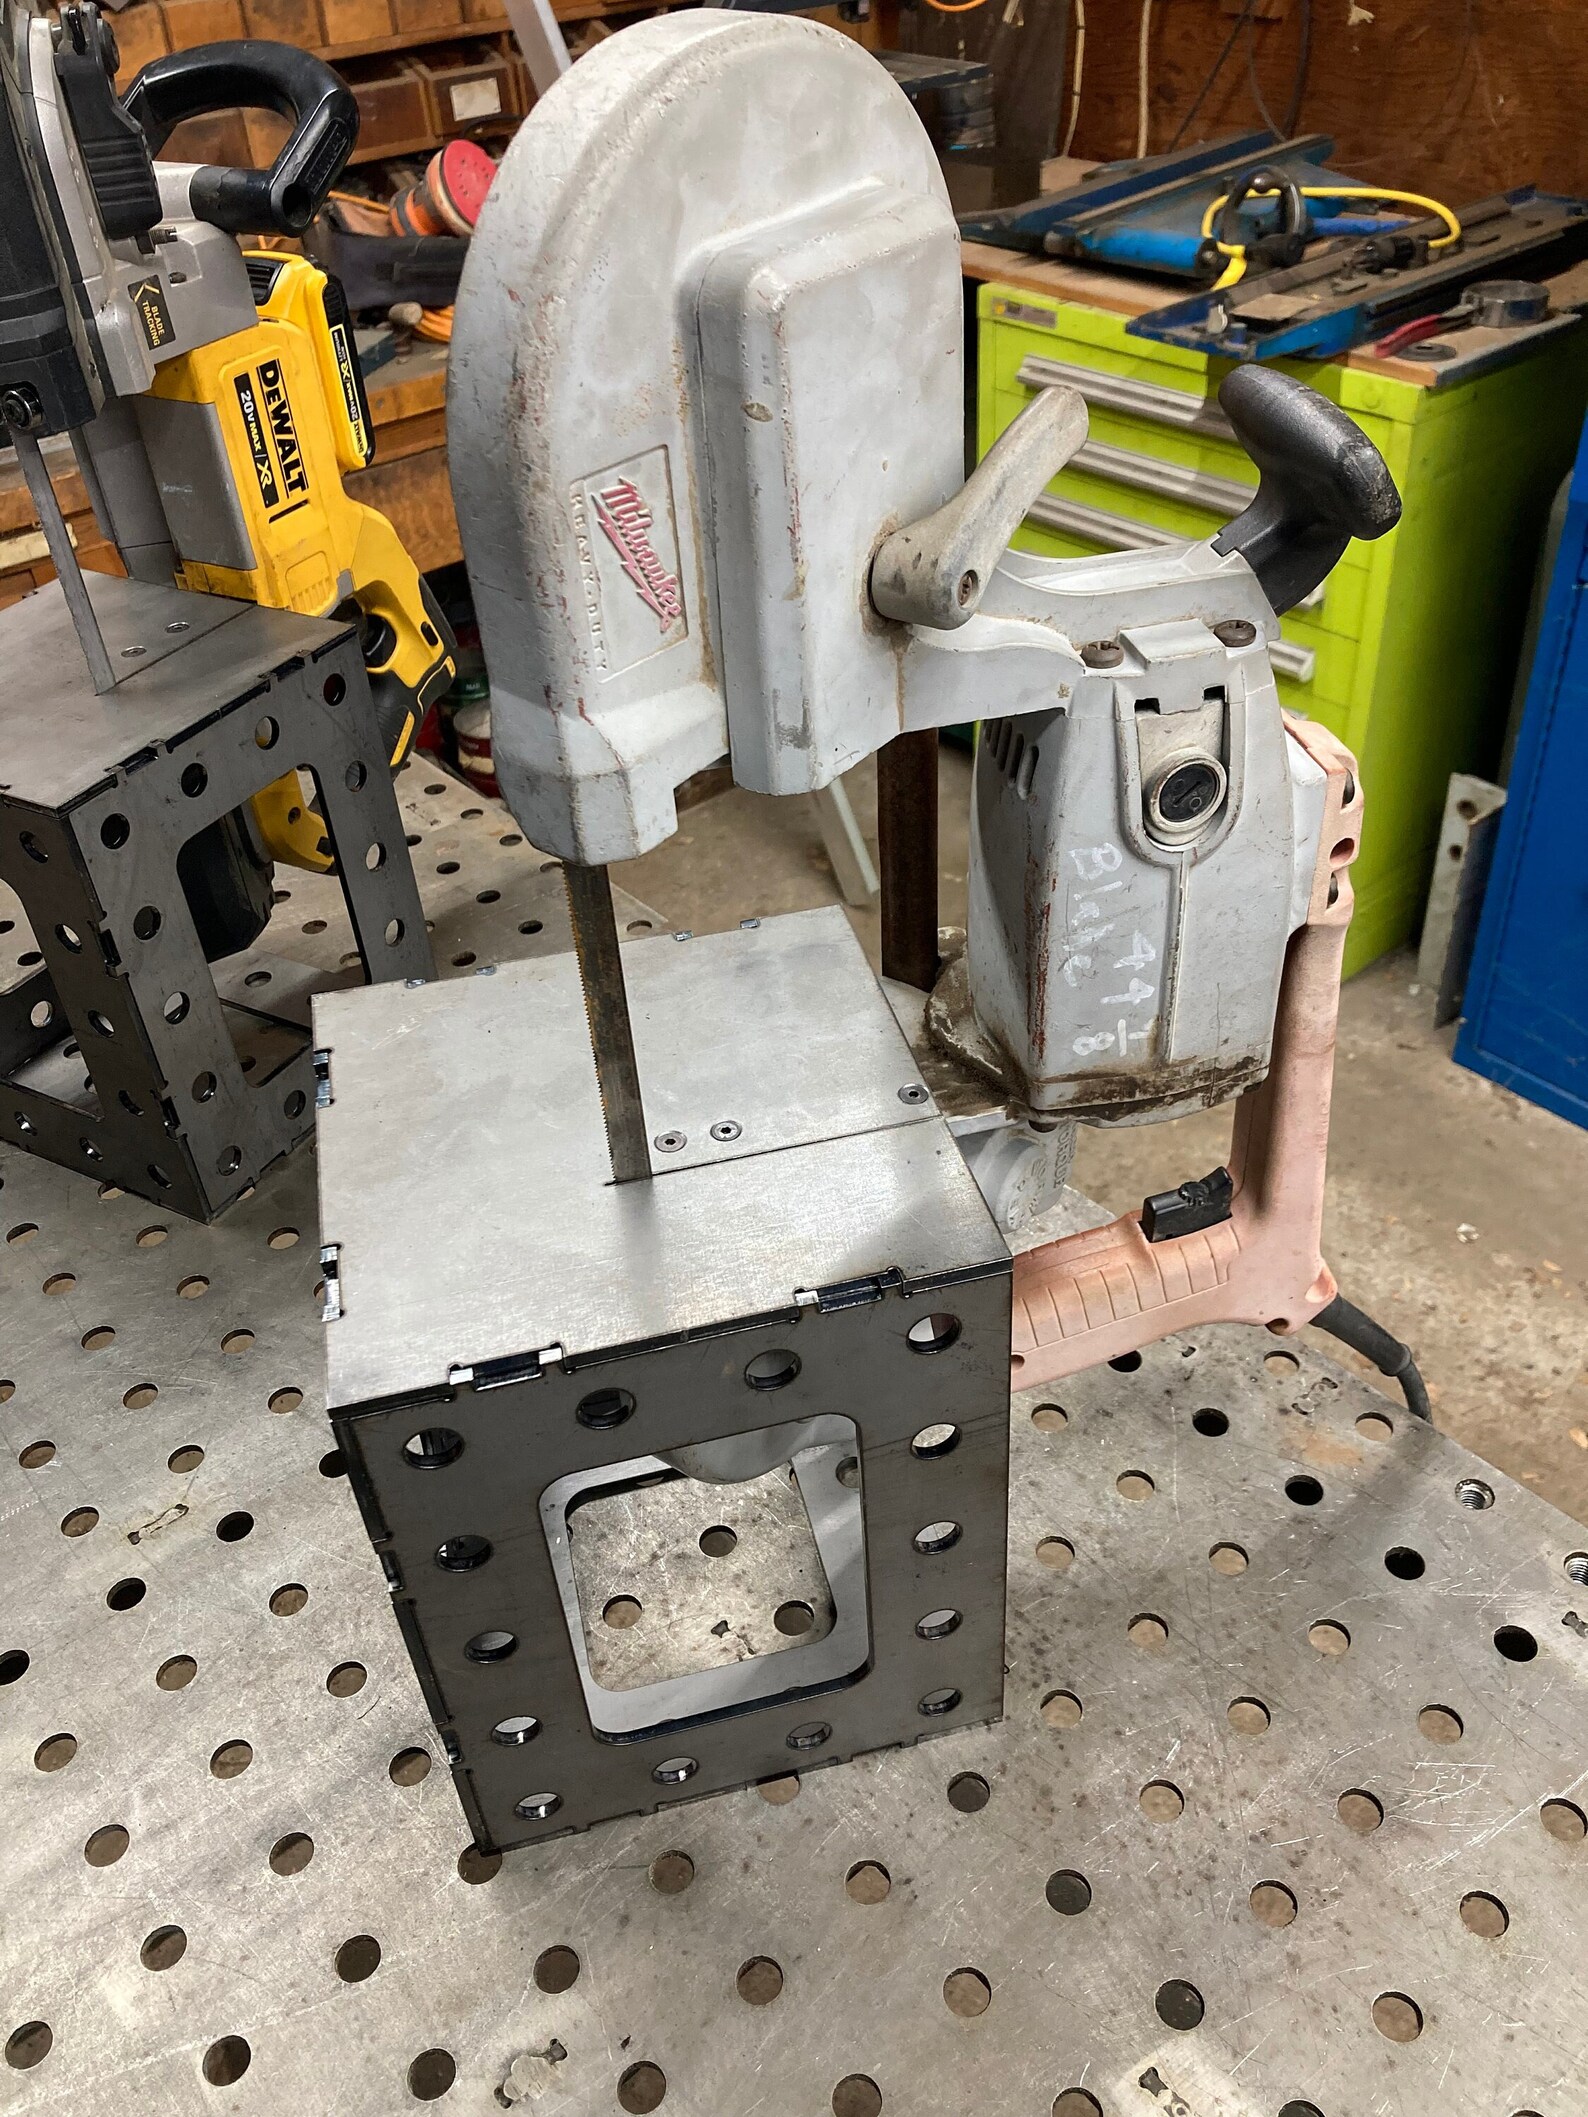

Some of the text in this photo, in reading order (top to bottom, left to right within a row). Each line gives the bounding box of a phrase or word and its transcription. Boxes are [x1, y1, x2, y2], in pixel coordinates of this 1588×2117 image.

[142, 300, 160, 346] TRACKING
[151, 306, 165, 336] BLADE
[340, 360, 351, 380] XR
[258, 359, 307, 493] DEWALT
[256, 459, 273, 490] XR
[600, 475, 682, 617] Milwaukee
